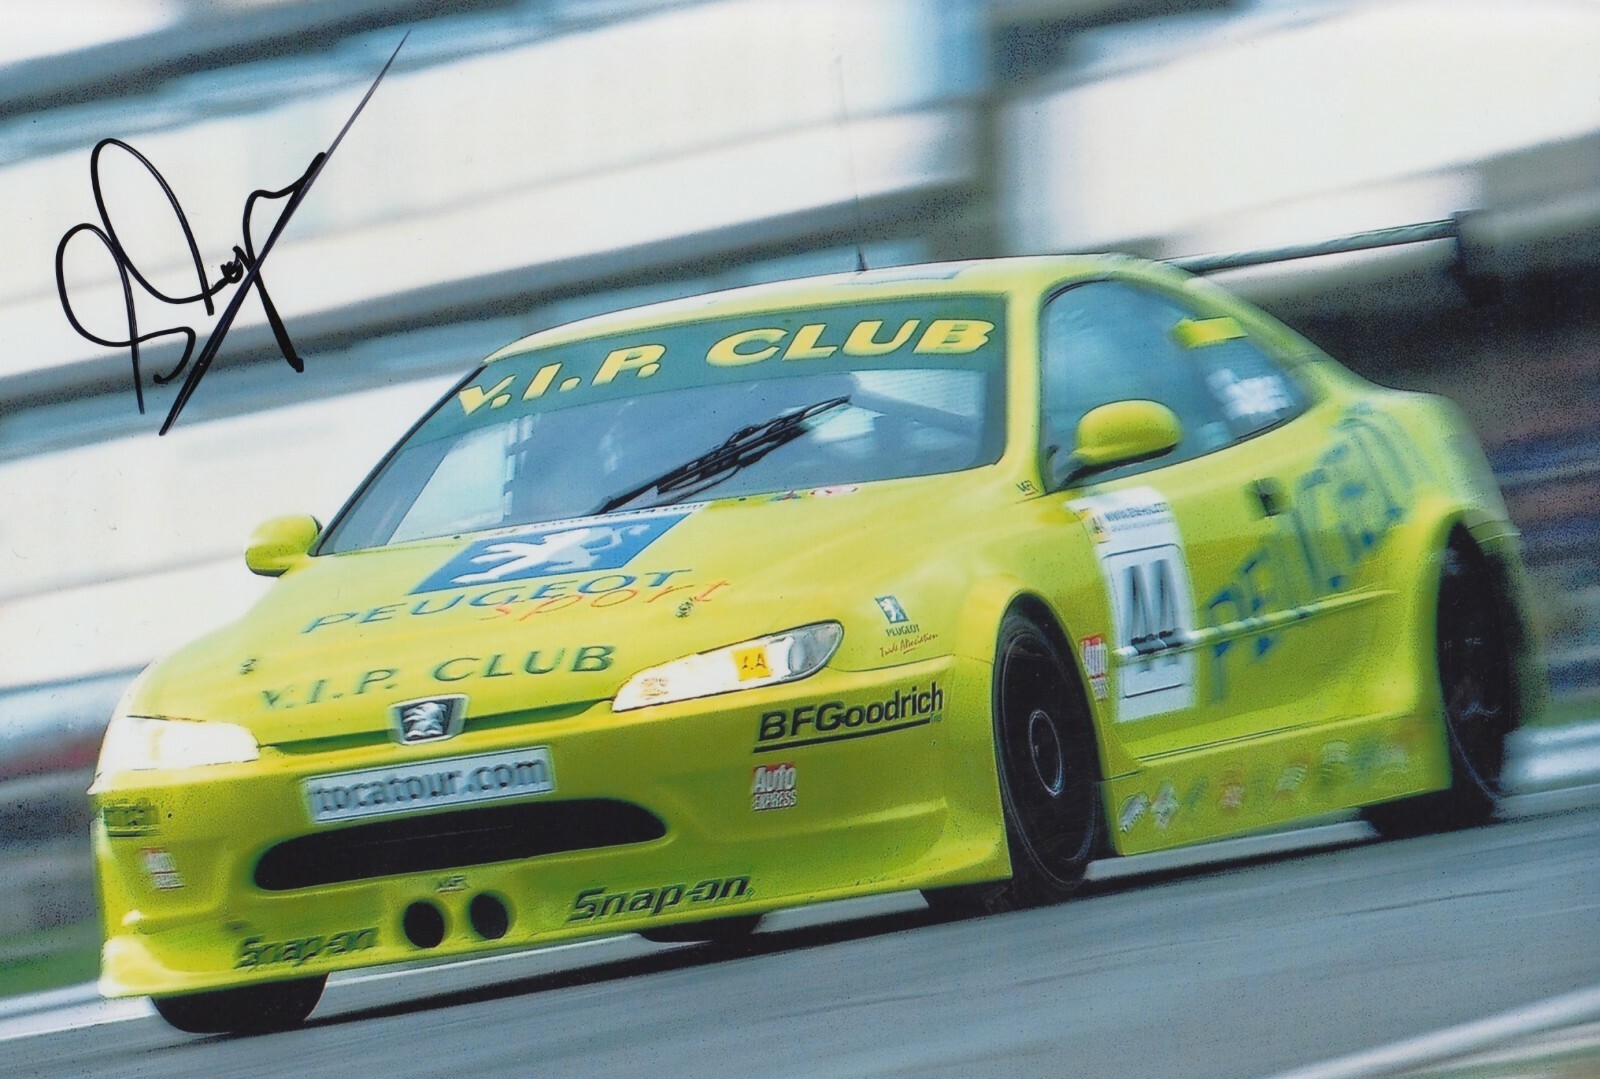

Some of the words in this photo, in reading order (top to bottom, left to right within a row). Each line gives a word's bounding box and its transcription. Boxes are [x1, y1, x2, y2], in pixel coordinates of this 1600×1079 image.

[458, 343, 667, 416] V.I.P.
[705, 318, 996, 368] CLUB
[301, 568, 692, 634] PEUGEOT
[480, 579, 730, 621] sport
[261, 668, 399, 711] V.I.P.
[432, 644, 616, 683] CLUB
[758, 681, 944, 742] BFGoodrich
[308, 758, 550, 812] tocatour.com
[565, 875, 751, 922] Snap-on
